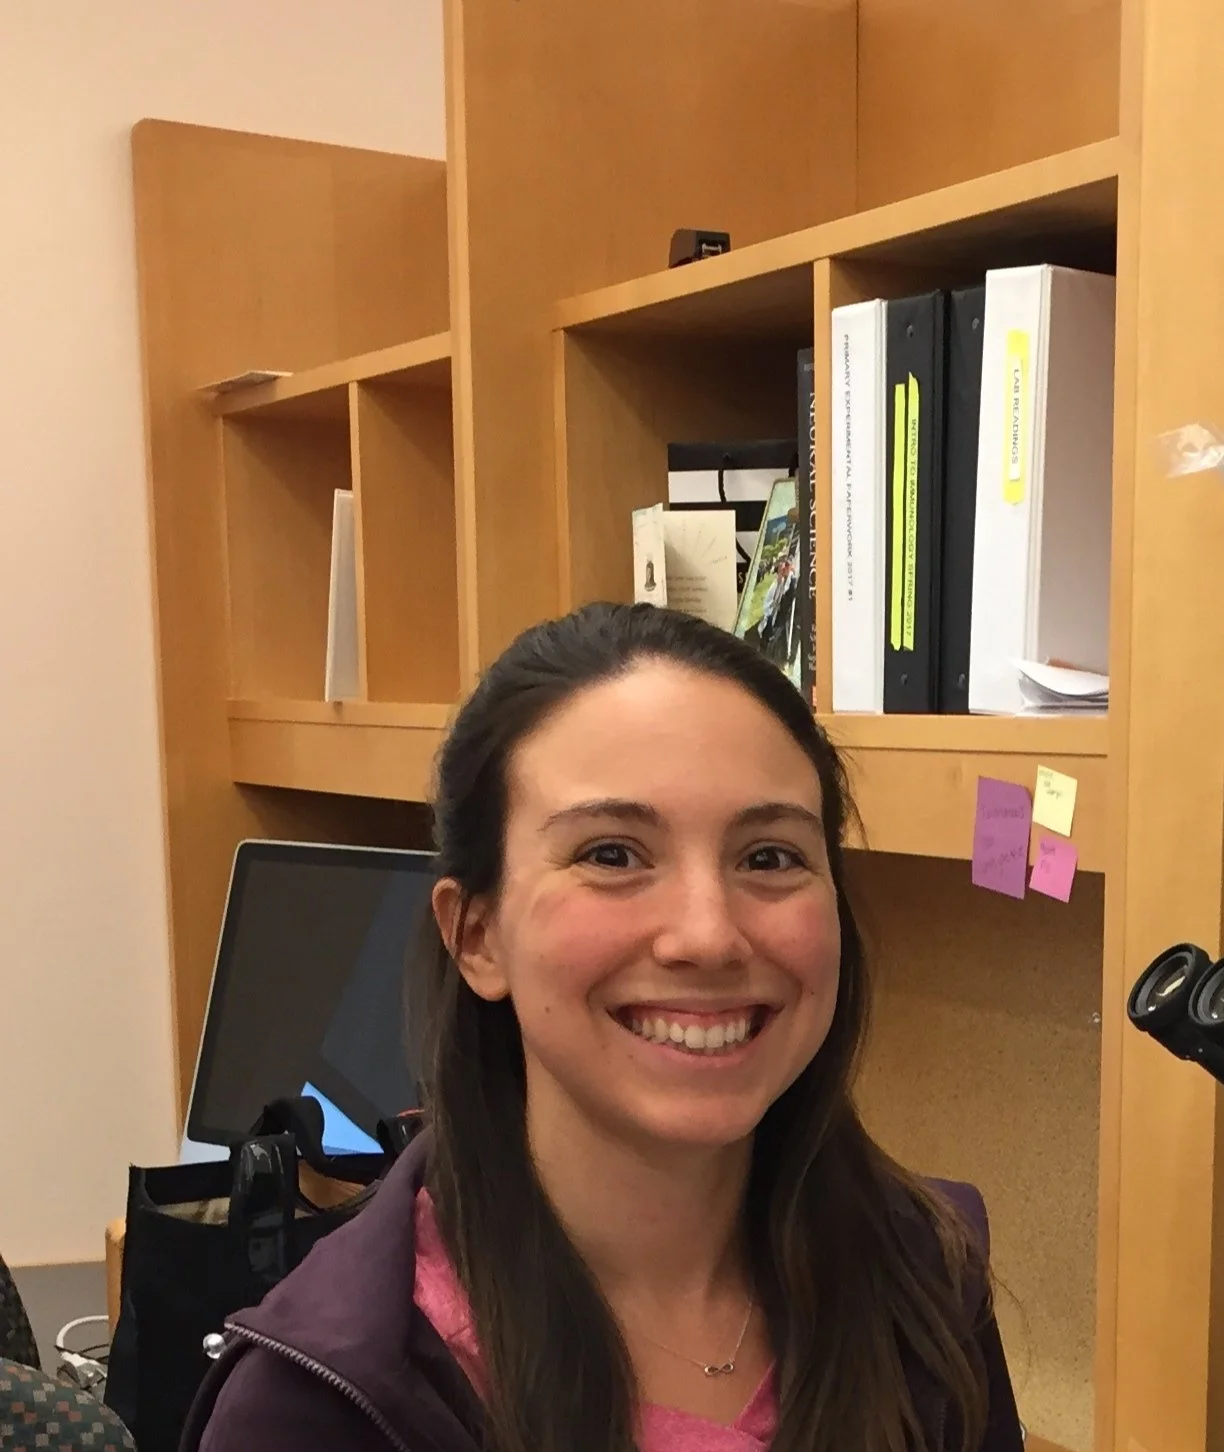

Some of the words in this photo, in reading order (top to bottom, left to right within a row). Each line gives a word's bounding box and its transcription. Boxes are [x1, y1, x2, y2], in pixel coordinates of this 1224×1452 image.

[842, 333, 851, 388] PRIMARY
[1012, 368, 1021, 395] LAB
[843, 389, 853, 479] EXPERIMENTAL
[909, 418, 918, 456] INTRO
[1010, 397, 1020, 465] READINGS
[908, 459, 917, 476] TO
[845, 483, 853, 558] PAPERWORK
[906, 479, 917, 559] IMMUNOLOGY
[905, 563, 915, 609] SPRING
[904, 611, 913, 638] 2017
